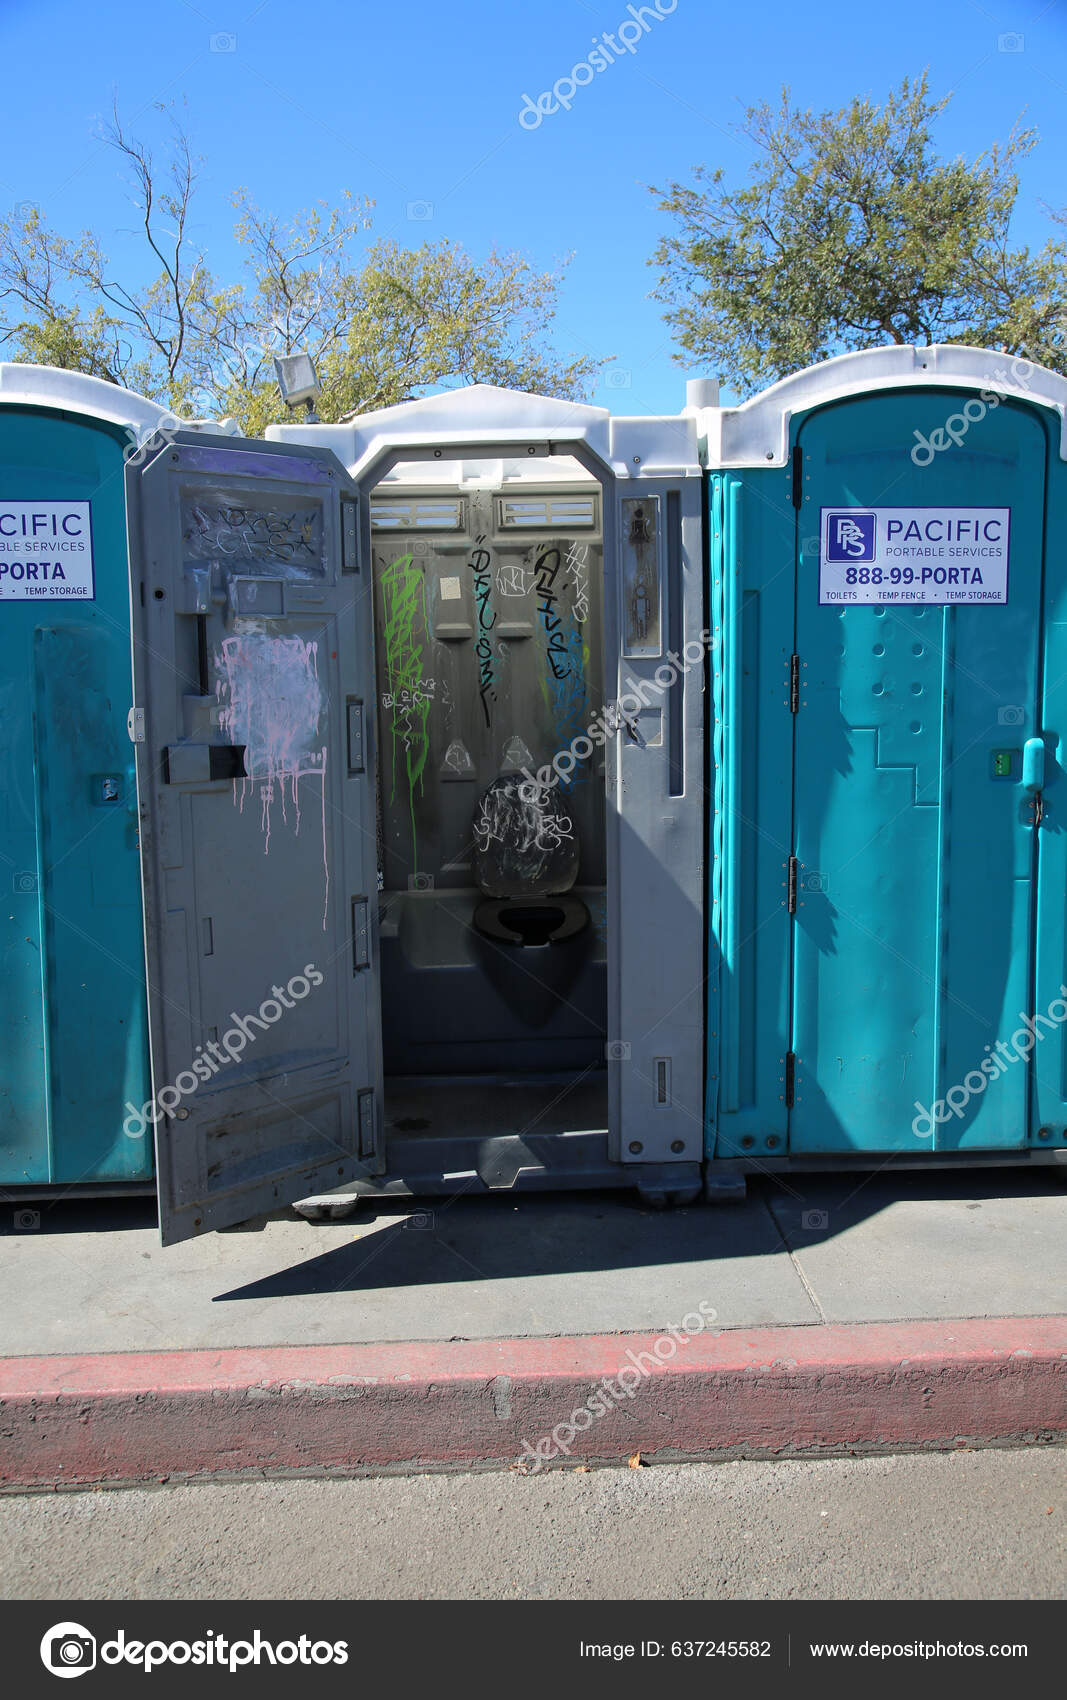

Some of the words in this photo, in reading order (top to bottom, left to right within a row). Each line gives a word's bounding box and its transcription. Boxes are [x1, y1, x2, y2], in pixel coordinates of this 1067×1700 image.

[887, 520, 1002, 541] PACIFIC
[25, 542, 85, 551] SERVICES
[886, 547, 944, 557] PORTABLE
[949, 547, 1002, 557] SERVICES
[845, 567, 983, 585] 888-99-PORTA
[25, 587, 47, 595] TEMP
[50, 587, 88, 595] STORAGE
[826, 591, 857, 600] TOILETS
[878, 591, 899, 600] TEMP
[901, 591, 926, 600] FENCE
[946, 591, 966, 600] TEMP
[968, 591, 1002, 600] STORAGE
